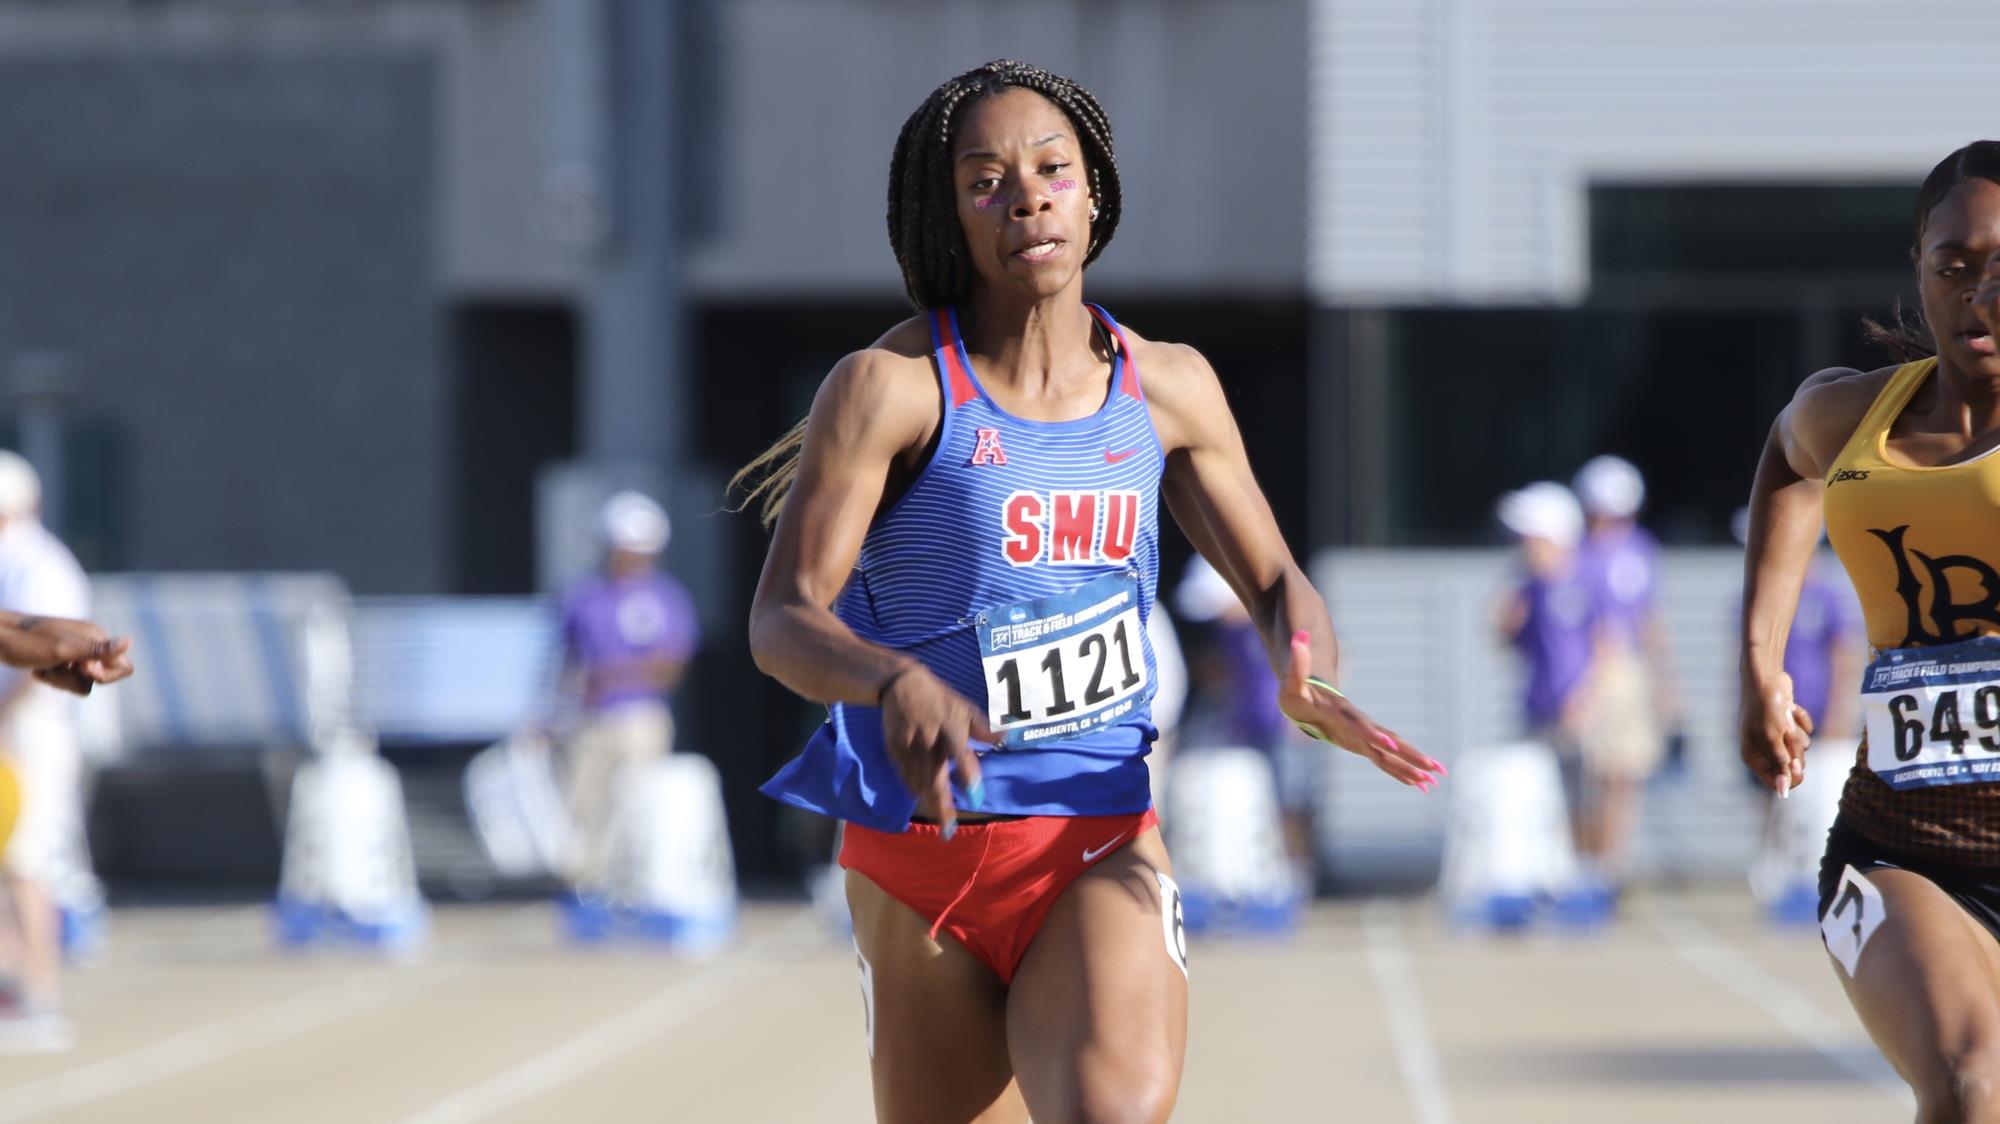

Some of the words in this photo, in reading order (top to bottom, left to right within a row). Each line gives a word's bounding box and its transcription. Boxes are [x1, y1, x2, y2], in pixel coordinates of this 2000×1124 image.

[1835, 469, 1870, 483] asics
[1002, 490, 1141, 567] SMU
[1011, 624, 1042, 641] TRACK
[1050, 615, 1074, 632] FIELD
[996, 619, 1140, 725] 1121
[1891, 666, 1914, 680] TRACK
[1920, 664, 1947, 677] FIELD
[1080, 717, 1091, 730] CA
[1888, 685, 2000, 762] 649
[1833, 879, 1863, 951] 7
